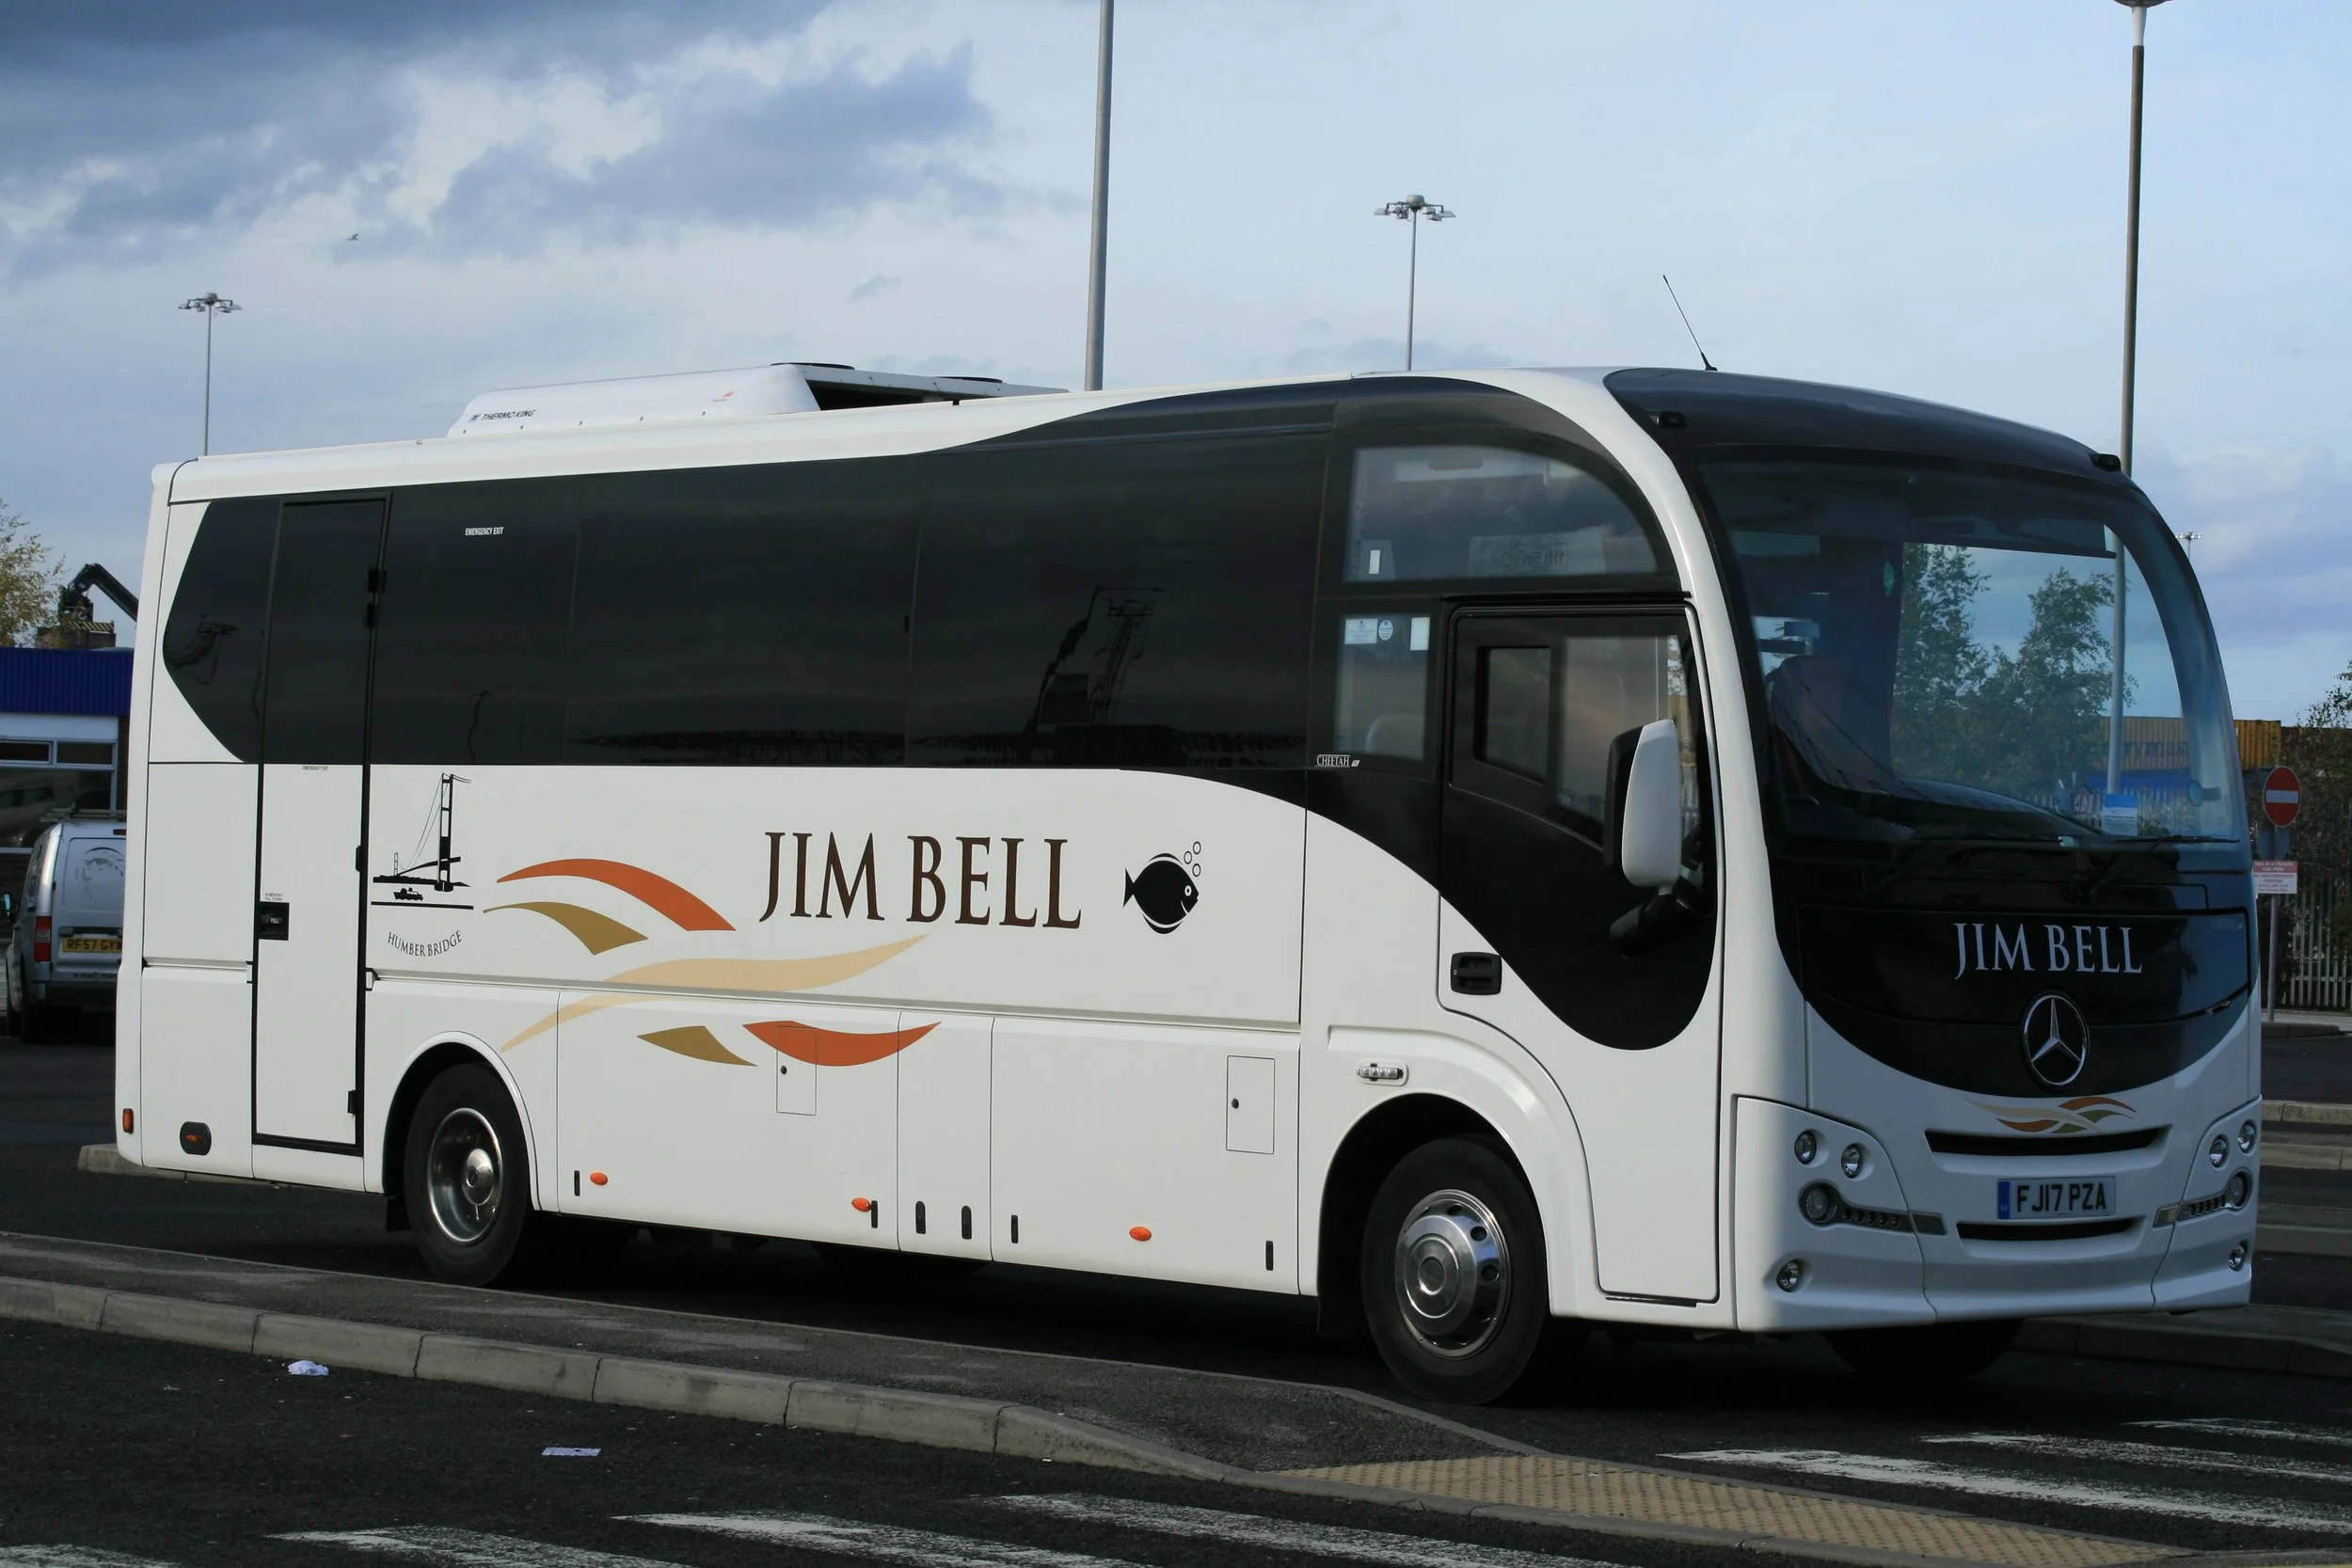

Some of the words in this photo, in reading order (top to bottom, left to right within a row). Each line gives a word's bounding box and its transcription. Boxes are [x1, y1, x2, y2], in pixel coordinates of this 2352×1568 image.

[481, 411, 516, 420] THERMO
[515, 409, 536, 419] KING
[465, 527, 493, 536] EMERGENCY
[493, 526, 504, 535] EXIT
[1316, 754, 1351, 768] CHEETAH
[759, 831, 885, 923] JIM
[906, 835, 1082, 929] BELL
[67, 939, 98, 950] RF57
[388, 931, 426, 957] HUMBER
[427, 930, 463, 957] BRIDGE
[1953, 923, 2035, 980] JIM
[2043, 925, 2142, 974] BELL
[2017, 1183, 2063, 1212] FJ17
[2069, 1182, 2106, 1212] PZA
